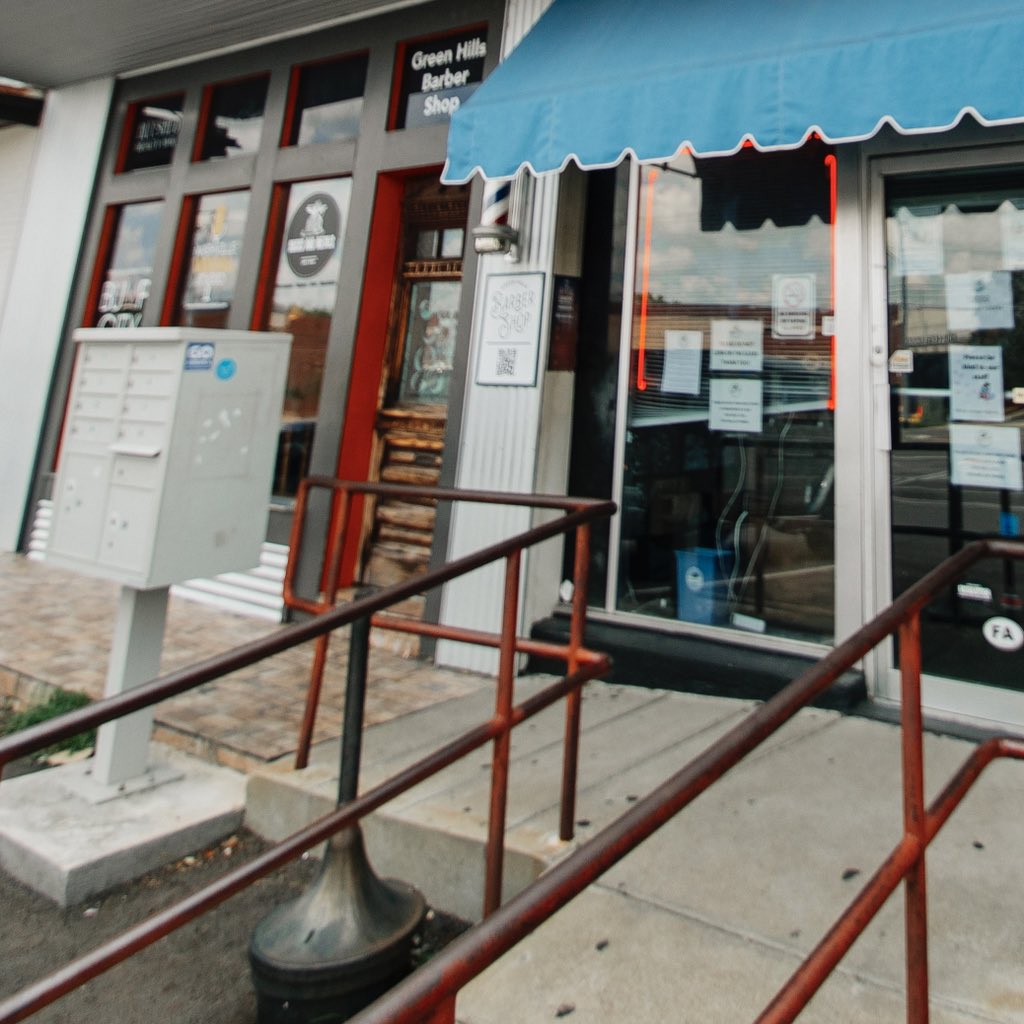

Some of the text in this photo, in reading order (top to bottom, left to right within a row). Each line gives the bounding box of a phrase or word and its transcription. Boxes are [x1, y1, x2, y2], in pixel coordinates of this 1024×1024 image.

[411, 37, 487, 71] Green Hills
[421, 67, 470, 93] Barber
[423, 94, 460, 117] Shop
[991, 624, 1015, 641] FA
